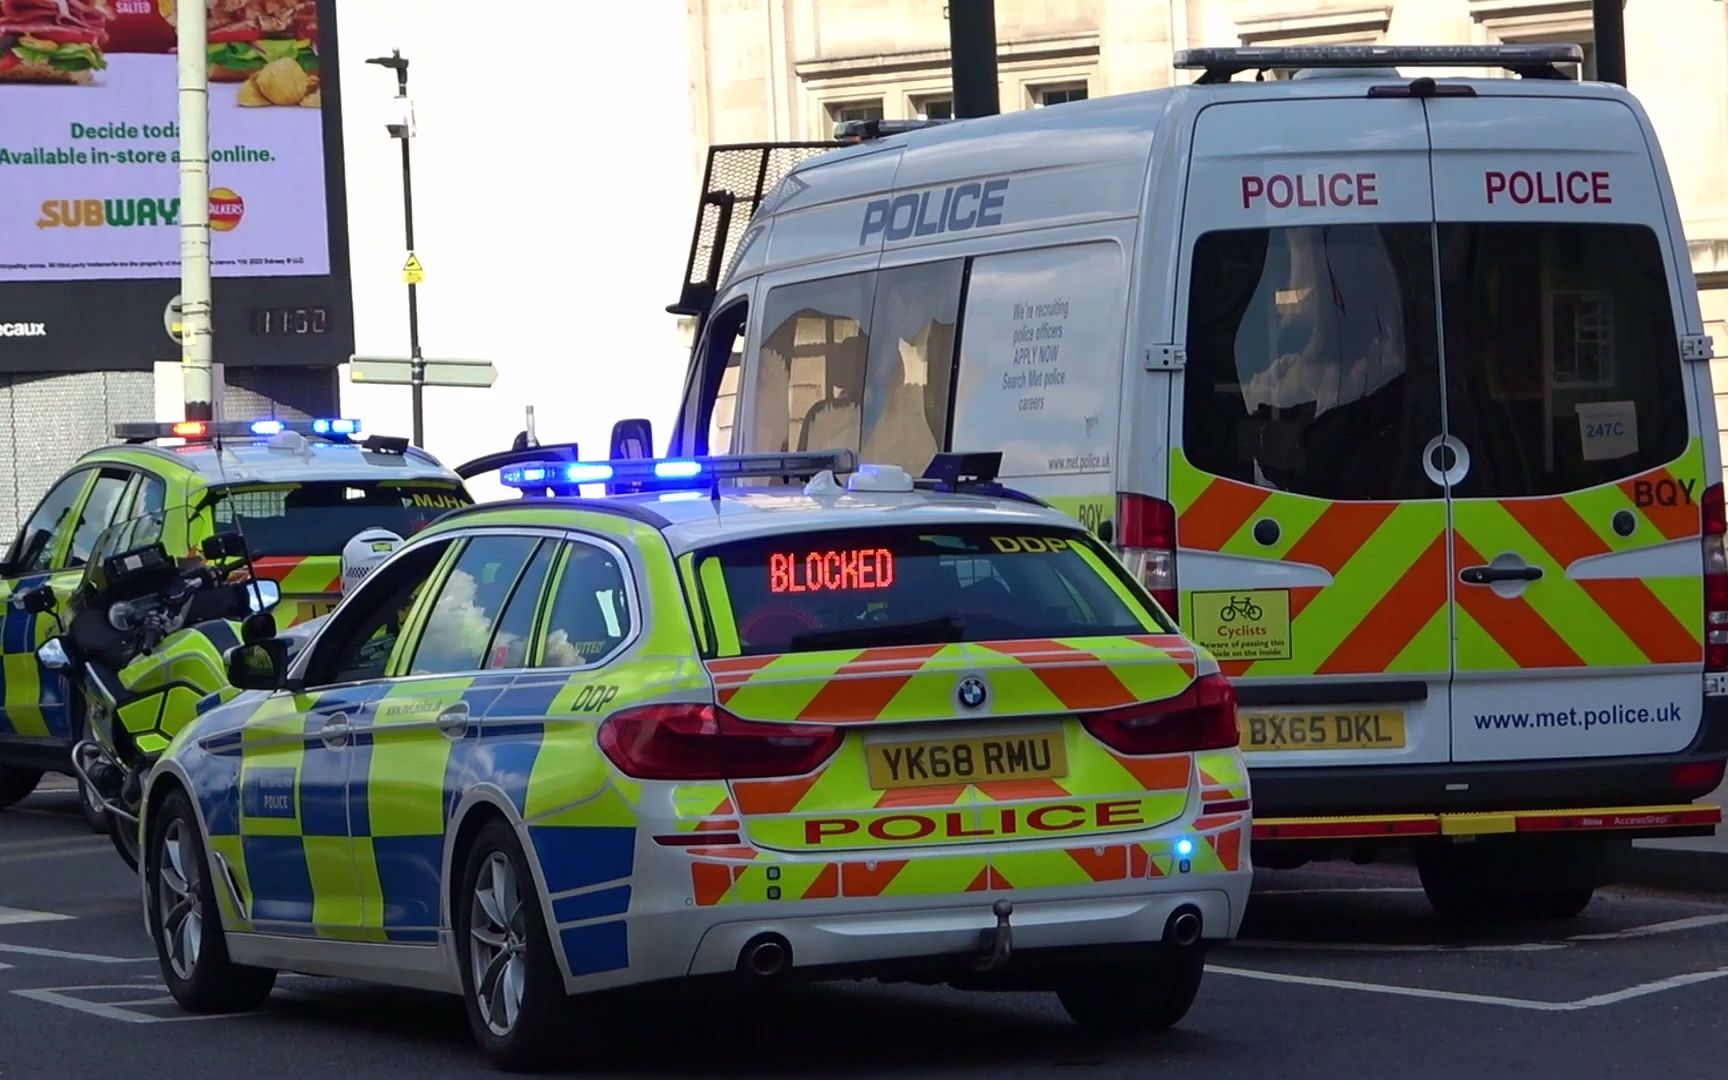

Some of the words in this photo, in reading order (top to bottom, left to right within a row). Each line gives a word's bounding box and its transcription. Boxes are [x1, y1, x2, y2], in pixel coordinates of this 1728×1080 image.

[70, 122, 138, 139] Decide
[0, 147, 87, 165] Available
[91, 147, 166, 163] in-store
[211, 145, 275, 163] online.
[1241, 172, 1379, 210] POLICE
[1485, 170, 1612, 205] POLICE
[37, 197, 180, 229] SUBWAY
[859, 178, 1010, 246] POLICE
[0, 322, 47, 337] caux
[1038, 344, 1060, 363] NOW
[1586, 422, 1625, 438] 247C
[1634, 478, 1696, 508] BQY
[990, 536, 1067, 553] DDP
[769, 548, 893, 593] BLOCKED
[1217, 625, 1267, 640] Cyclists
[570, 685, 619, 712] DDP
[1249, 715, 1327, 745] BX65
[1335, 714, 1393, 742] DKL
[1473, 702, 1682, 731] www.met.police.uk
[882, 744, 975, 781] YK68
[983, 738, 1051, 774] RMU
[804, 799, 1145, 845] POLICE
